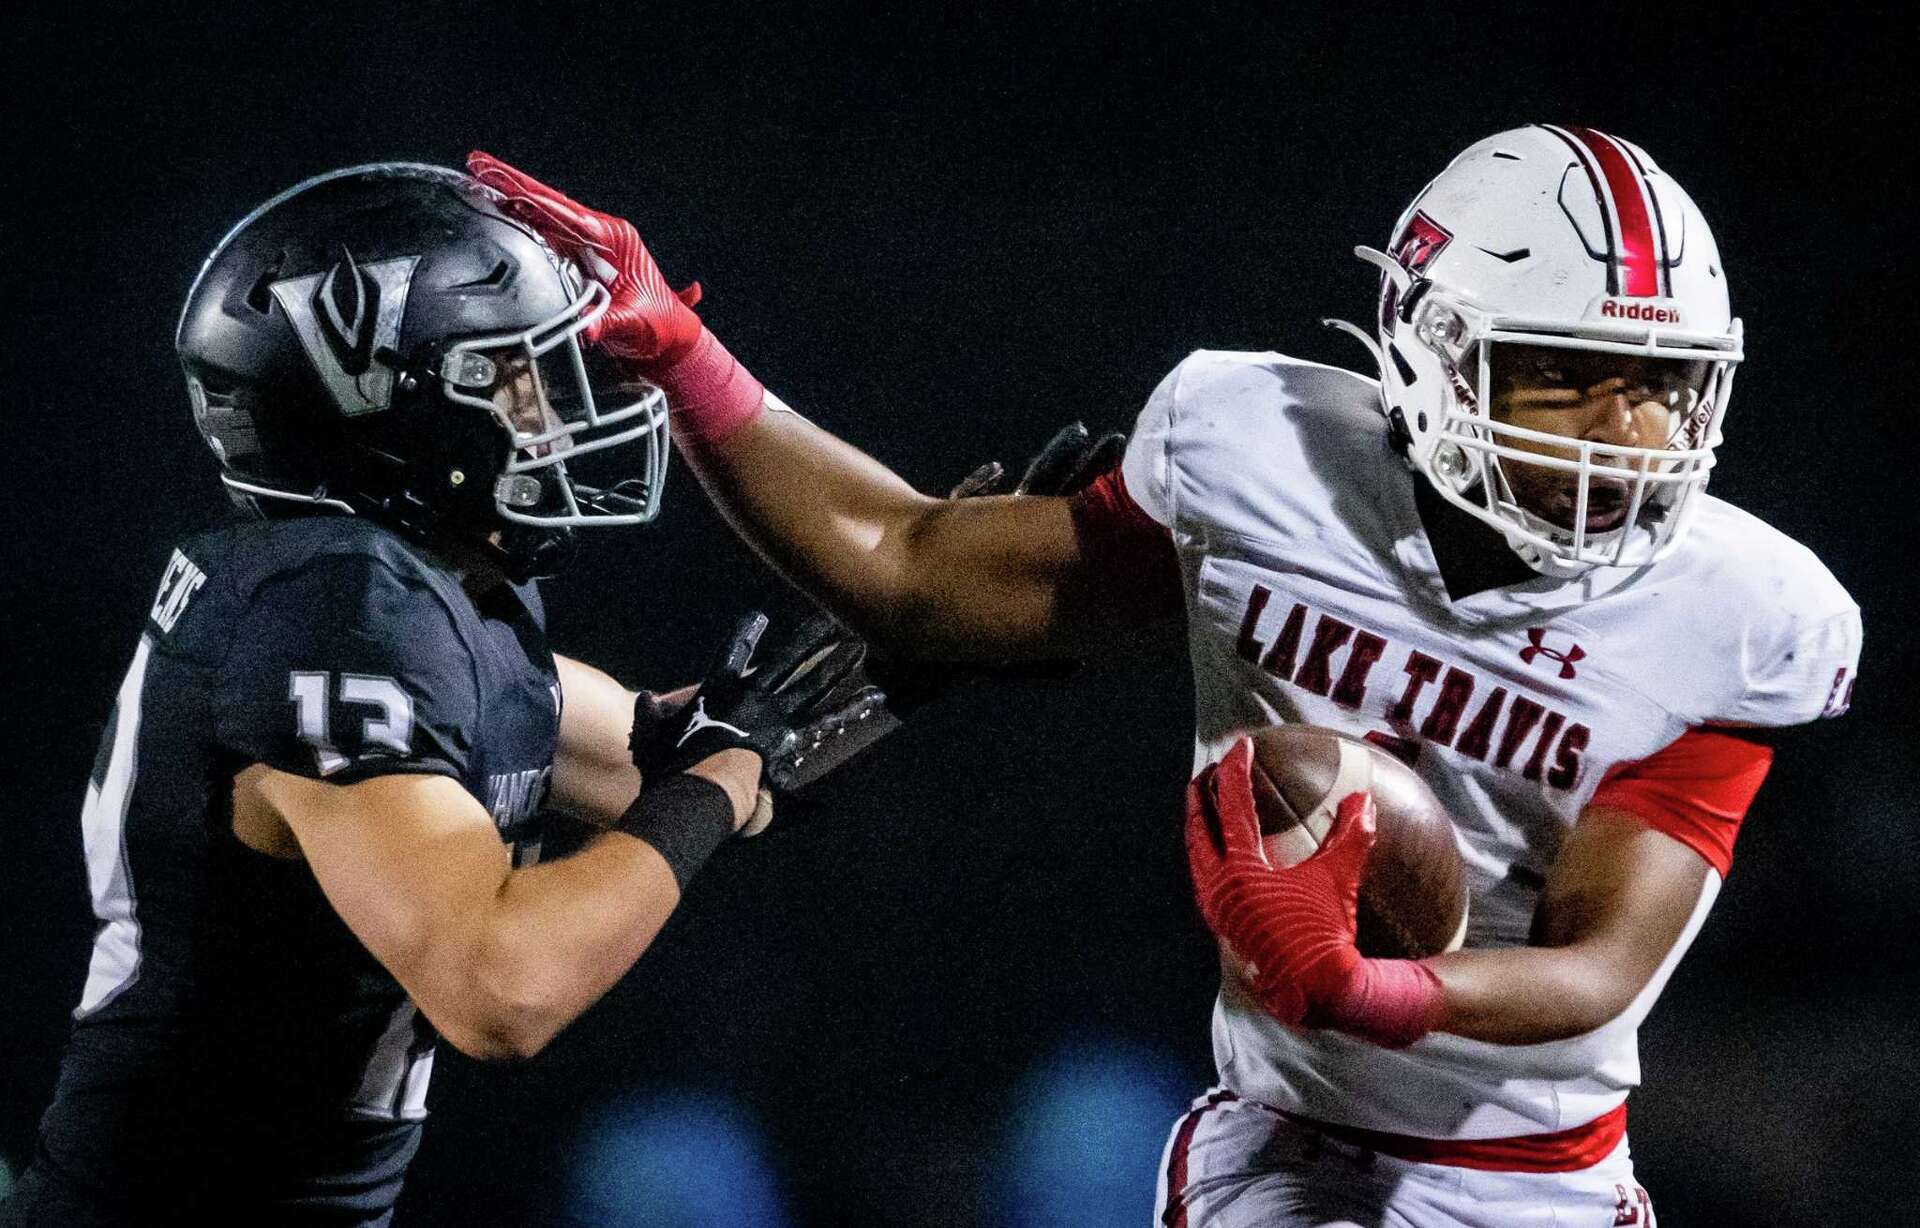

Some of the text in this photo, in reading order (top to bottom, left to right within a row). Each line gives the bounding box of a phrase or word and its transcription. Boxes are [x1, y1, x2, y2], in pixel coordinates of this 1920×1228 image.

[289, 670, 413, 776] 13
[1236, 583, 1592, 790] LAKE TRAVIS
